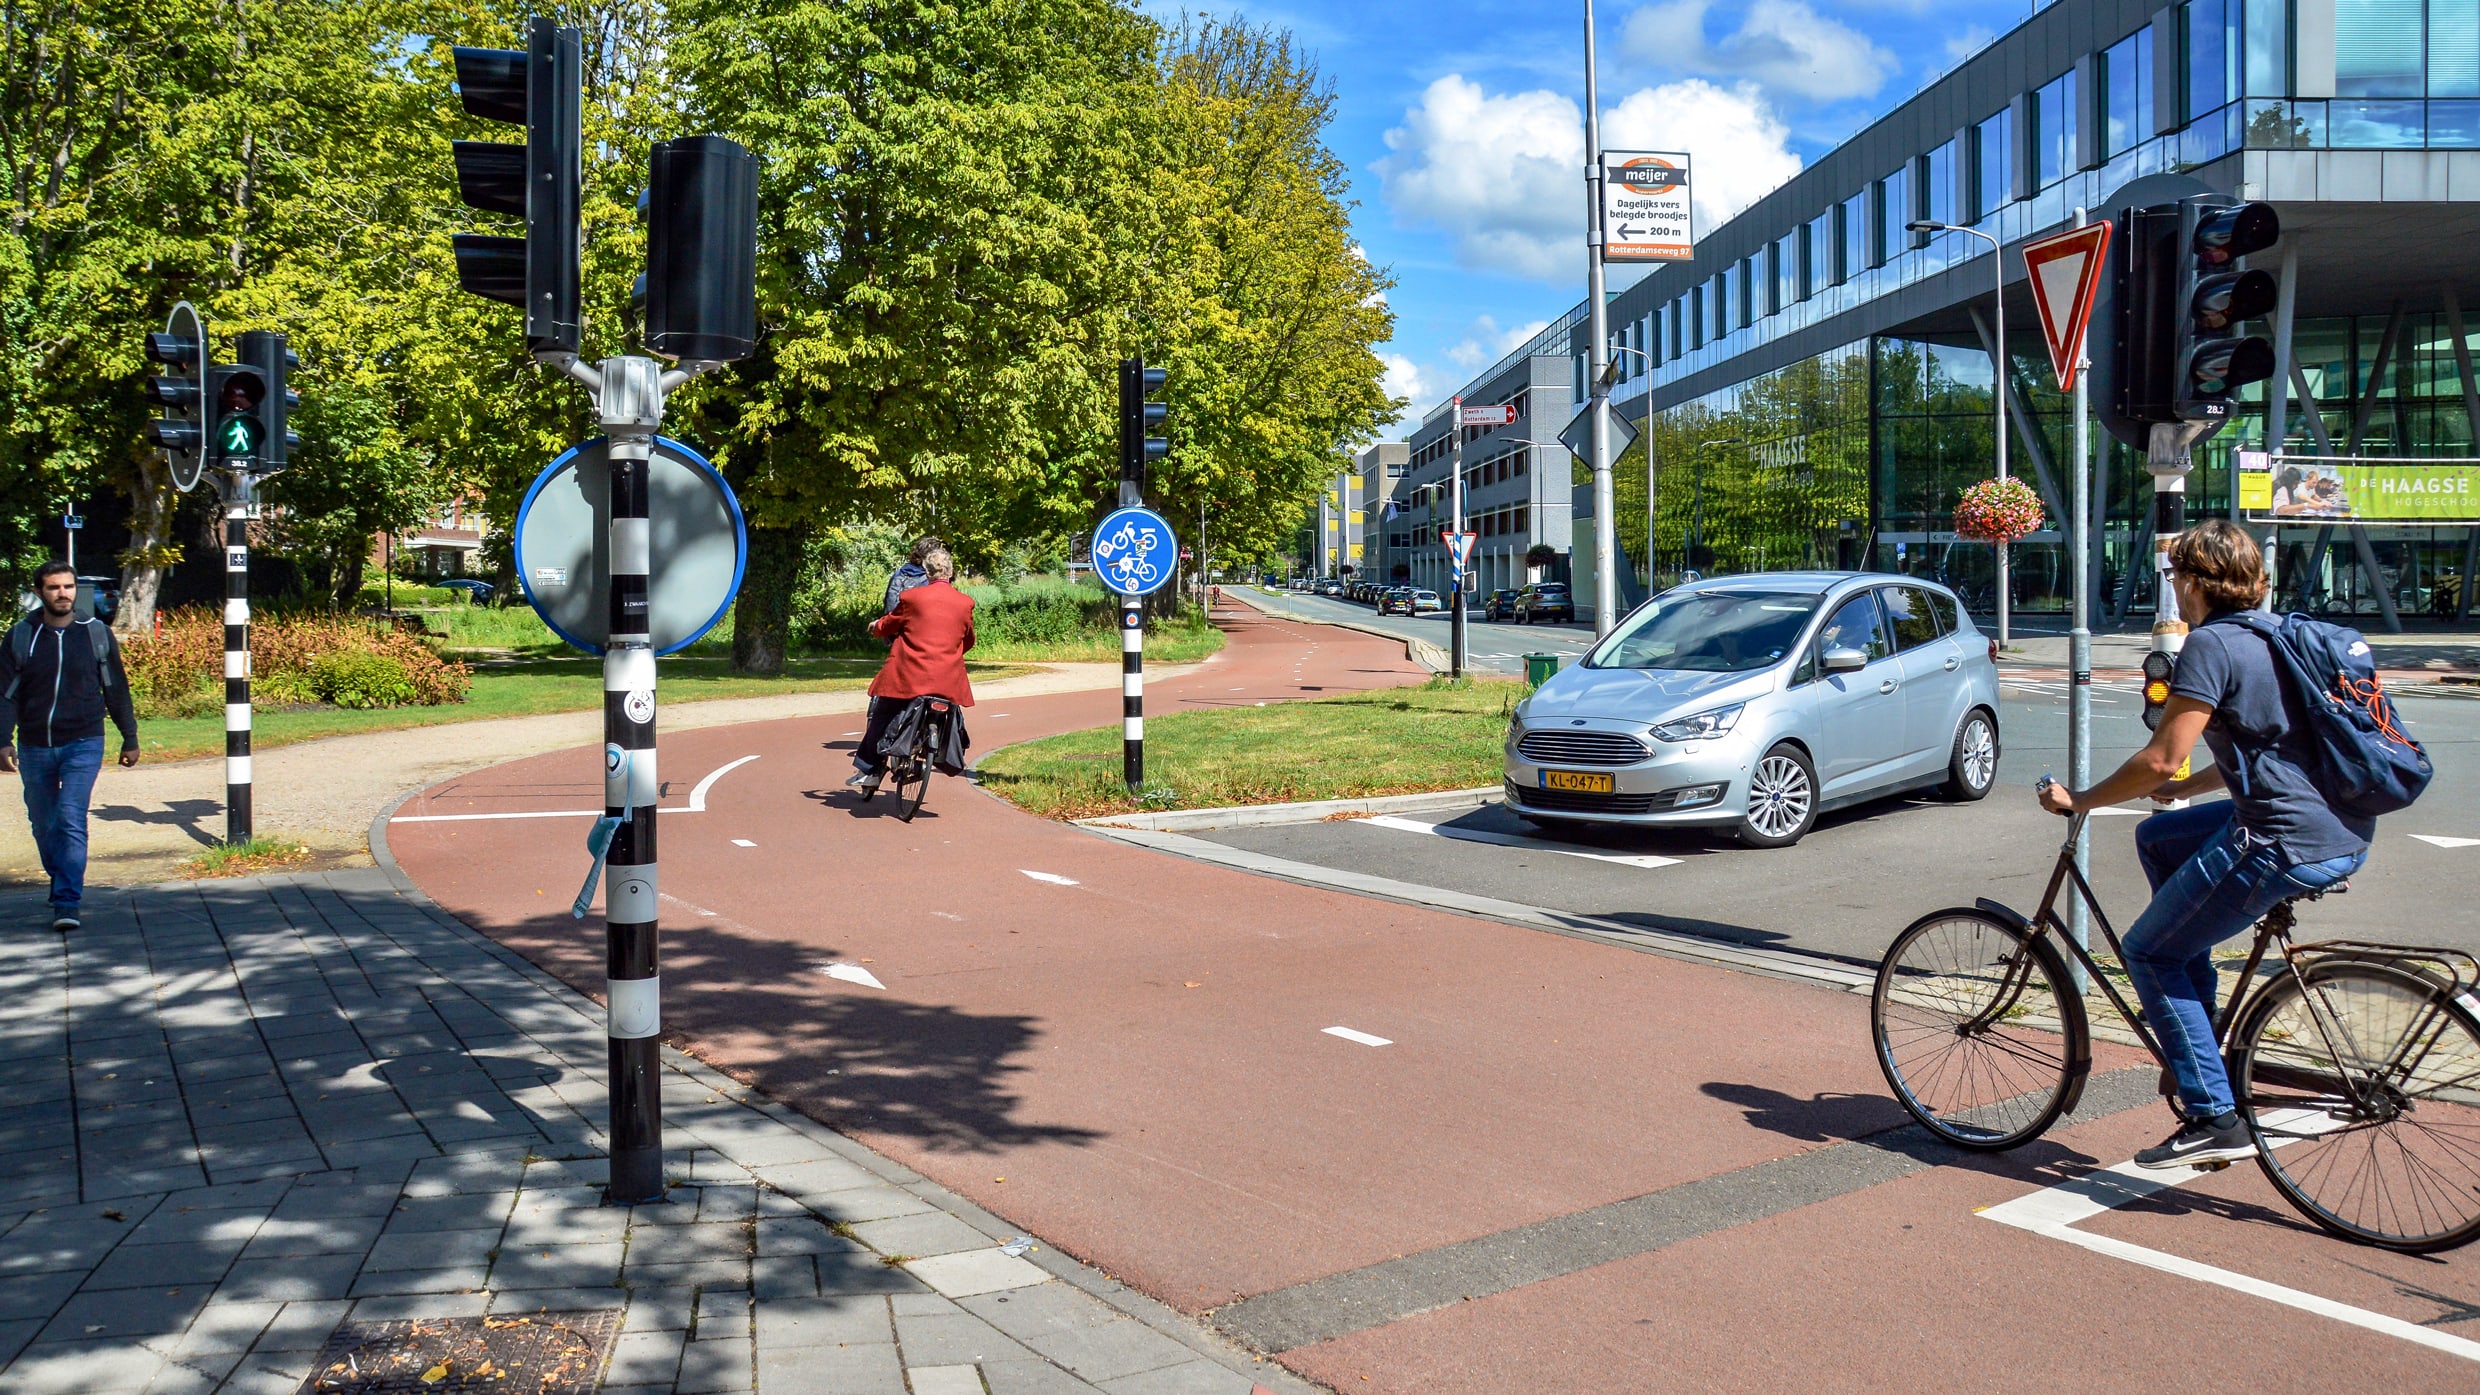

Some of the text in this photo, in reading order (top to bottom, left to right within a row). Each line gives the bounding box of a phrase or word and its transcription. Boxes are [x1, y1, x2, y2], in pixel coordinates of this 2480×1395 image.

[1626, 169, 1668, 183] meijer
[1617, 199, 1680, 210] Dagelijks vers
[1609, 210, 1688, 221] belegde broodjes
[1650, 227, 1670, 236] 200
[1609, 246, 1690, 256] Rotterdamseweg 97
[2206, 405, 2224, 414] 28.2
[1760, 435, 1806, 470] HAAGSE
[2248, 454, 2265, 467] 40
[2360, 478, 2469, 494] DE HAAGSE
[1549, 772, 1607, 792] KL-047-T
